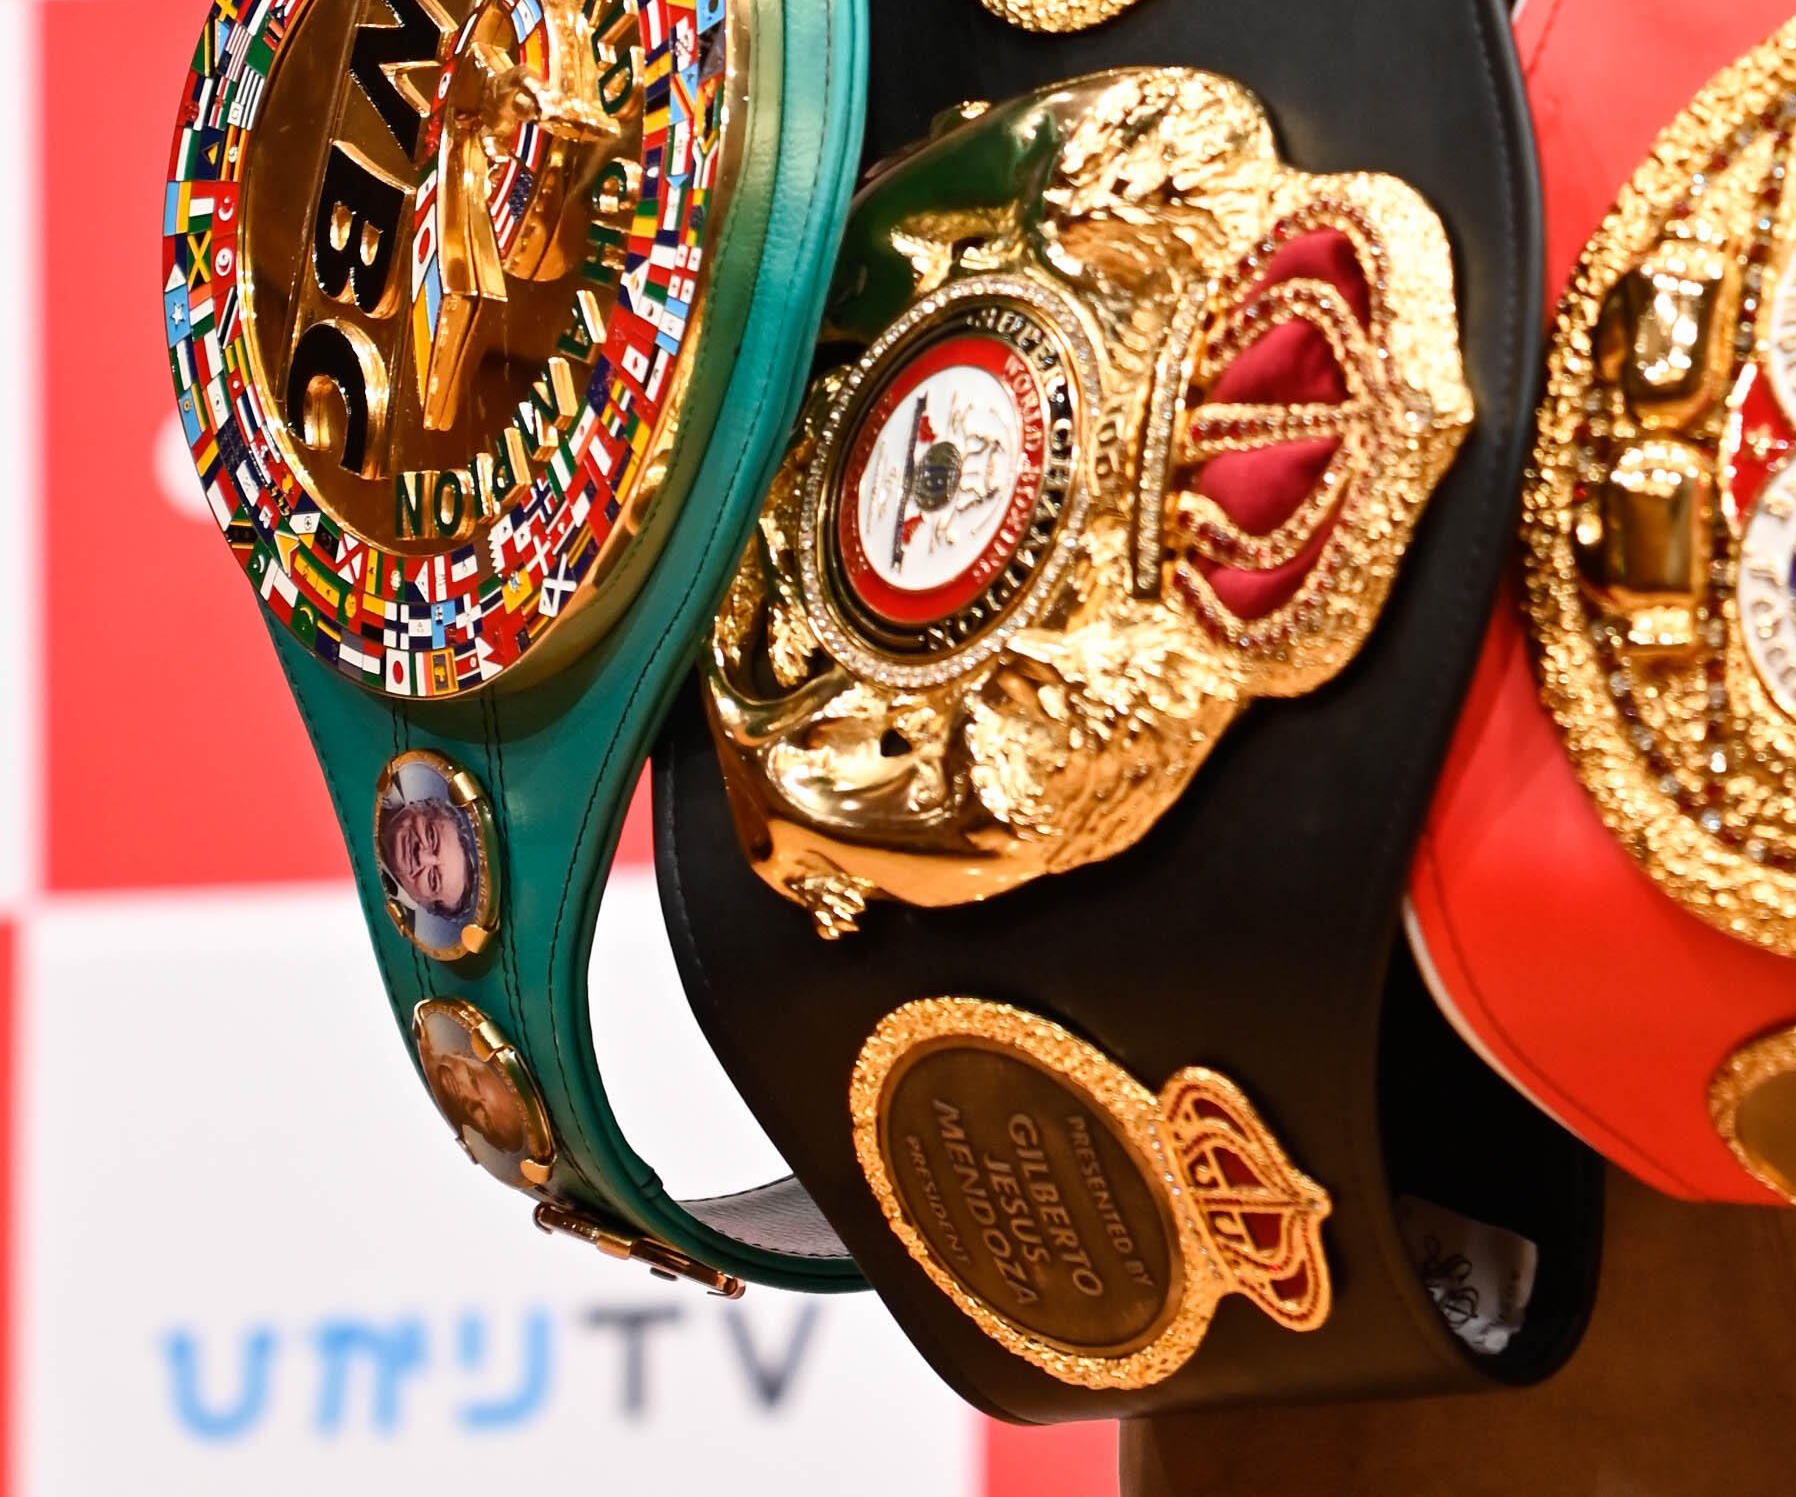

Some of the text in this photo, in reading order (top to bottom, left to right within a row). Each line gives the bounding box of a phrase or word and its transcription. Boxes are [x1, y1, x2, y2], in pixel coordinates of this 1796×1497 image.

[904, 1134, 970, 1264] PRESIDENT
[932, 1098, 1040, 1305] MENDOZA
[984, 1155, 1050, 1264] JESUS
[1007, 1111, 1104, 1298] GILBERTO
[1064, 1114, 1155, 1288] PRESENTED BY
[164, 1300, 826, 1440] ひかりTV
